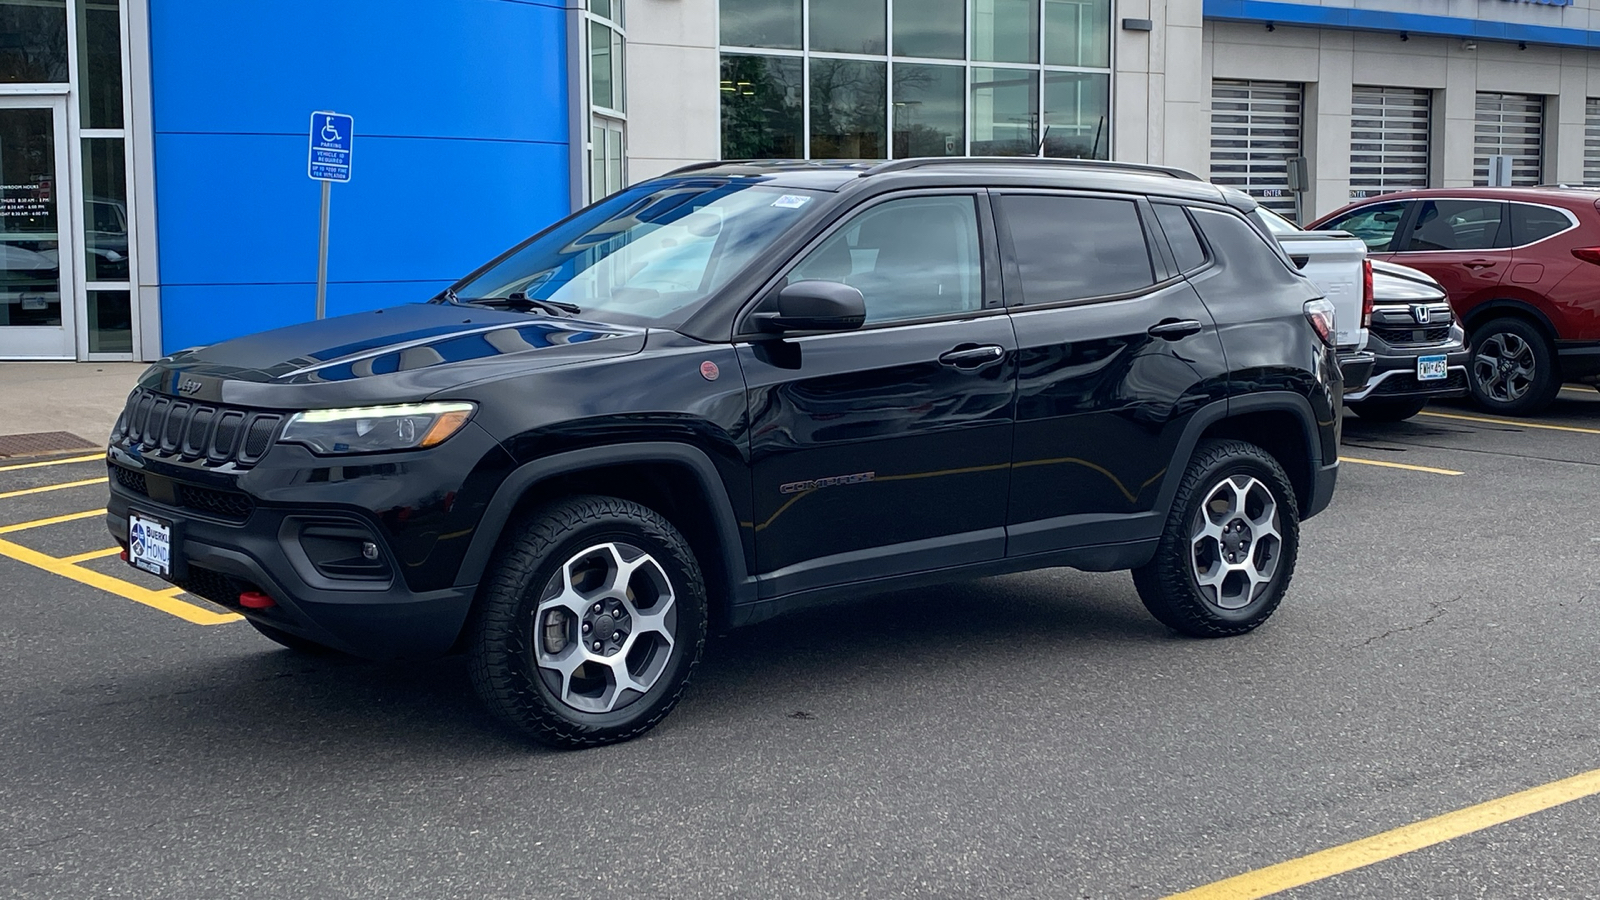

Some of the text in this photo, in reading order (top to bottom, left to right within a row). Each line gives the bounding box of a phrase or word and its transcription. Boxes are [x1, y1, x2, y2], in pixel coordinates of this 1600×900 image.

[1263, 189, 1282, 197] ENTER
[780, 472, 875, 494] COMPASS
[146, 538, 169, 562] HOND
